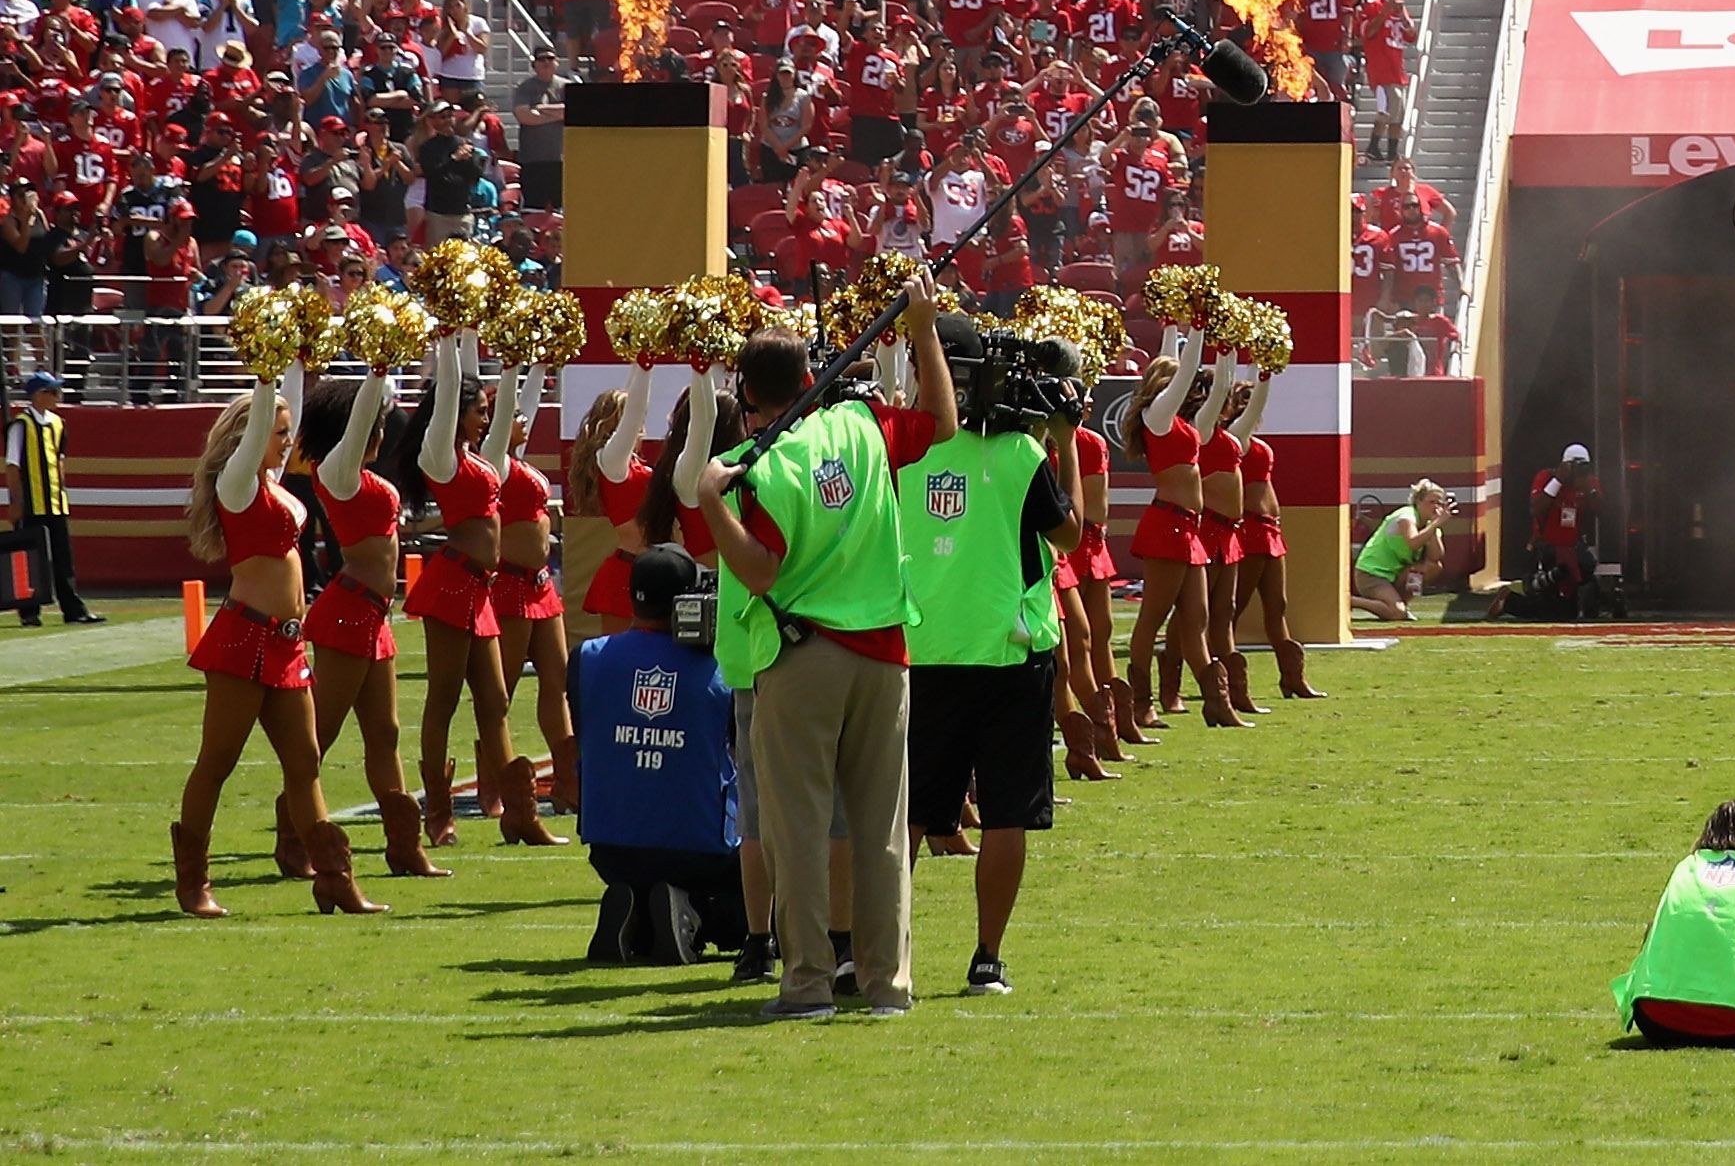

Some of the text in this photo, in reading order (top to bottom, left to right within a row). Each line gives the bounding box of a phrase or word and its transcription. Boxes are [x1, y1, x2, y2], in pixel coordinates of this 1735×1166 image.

[1088, 13, 1116, 41] 21
[74, 154, 103, 183] 16
[1125, 167, 1160, 201] 52
[1399, 241, 1434, 272] 52
[821, 476, 851, 504] NFL
[930, 492, 962, 515] NFL
[934, 537, 954, 555] 35
[637, 688, 668, 711] NFL
[615, 724, 685, 748] NFL FILMS
[636, 749, 663, 770] 119
